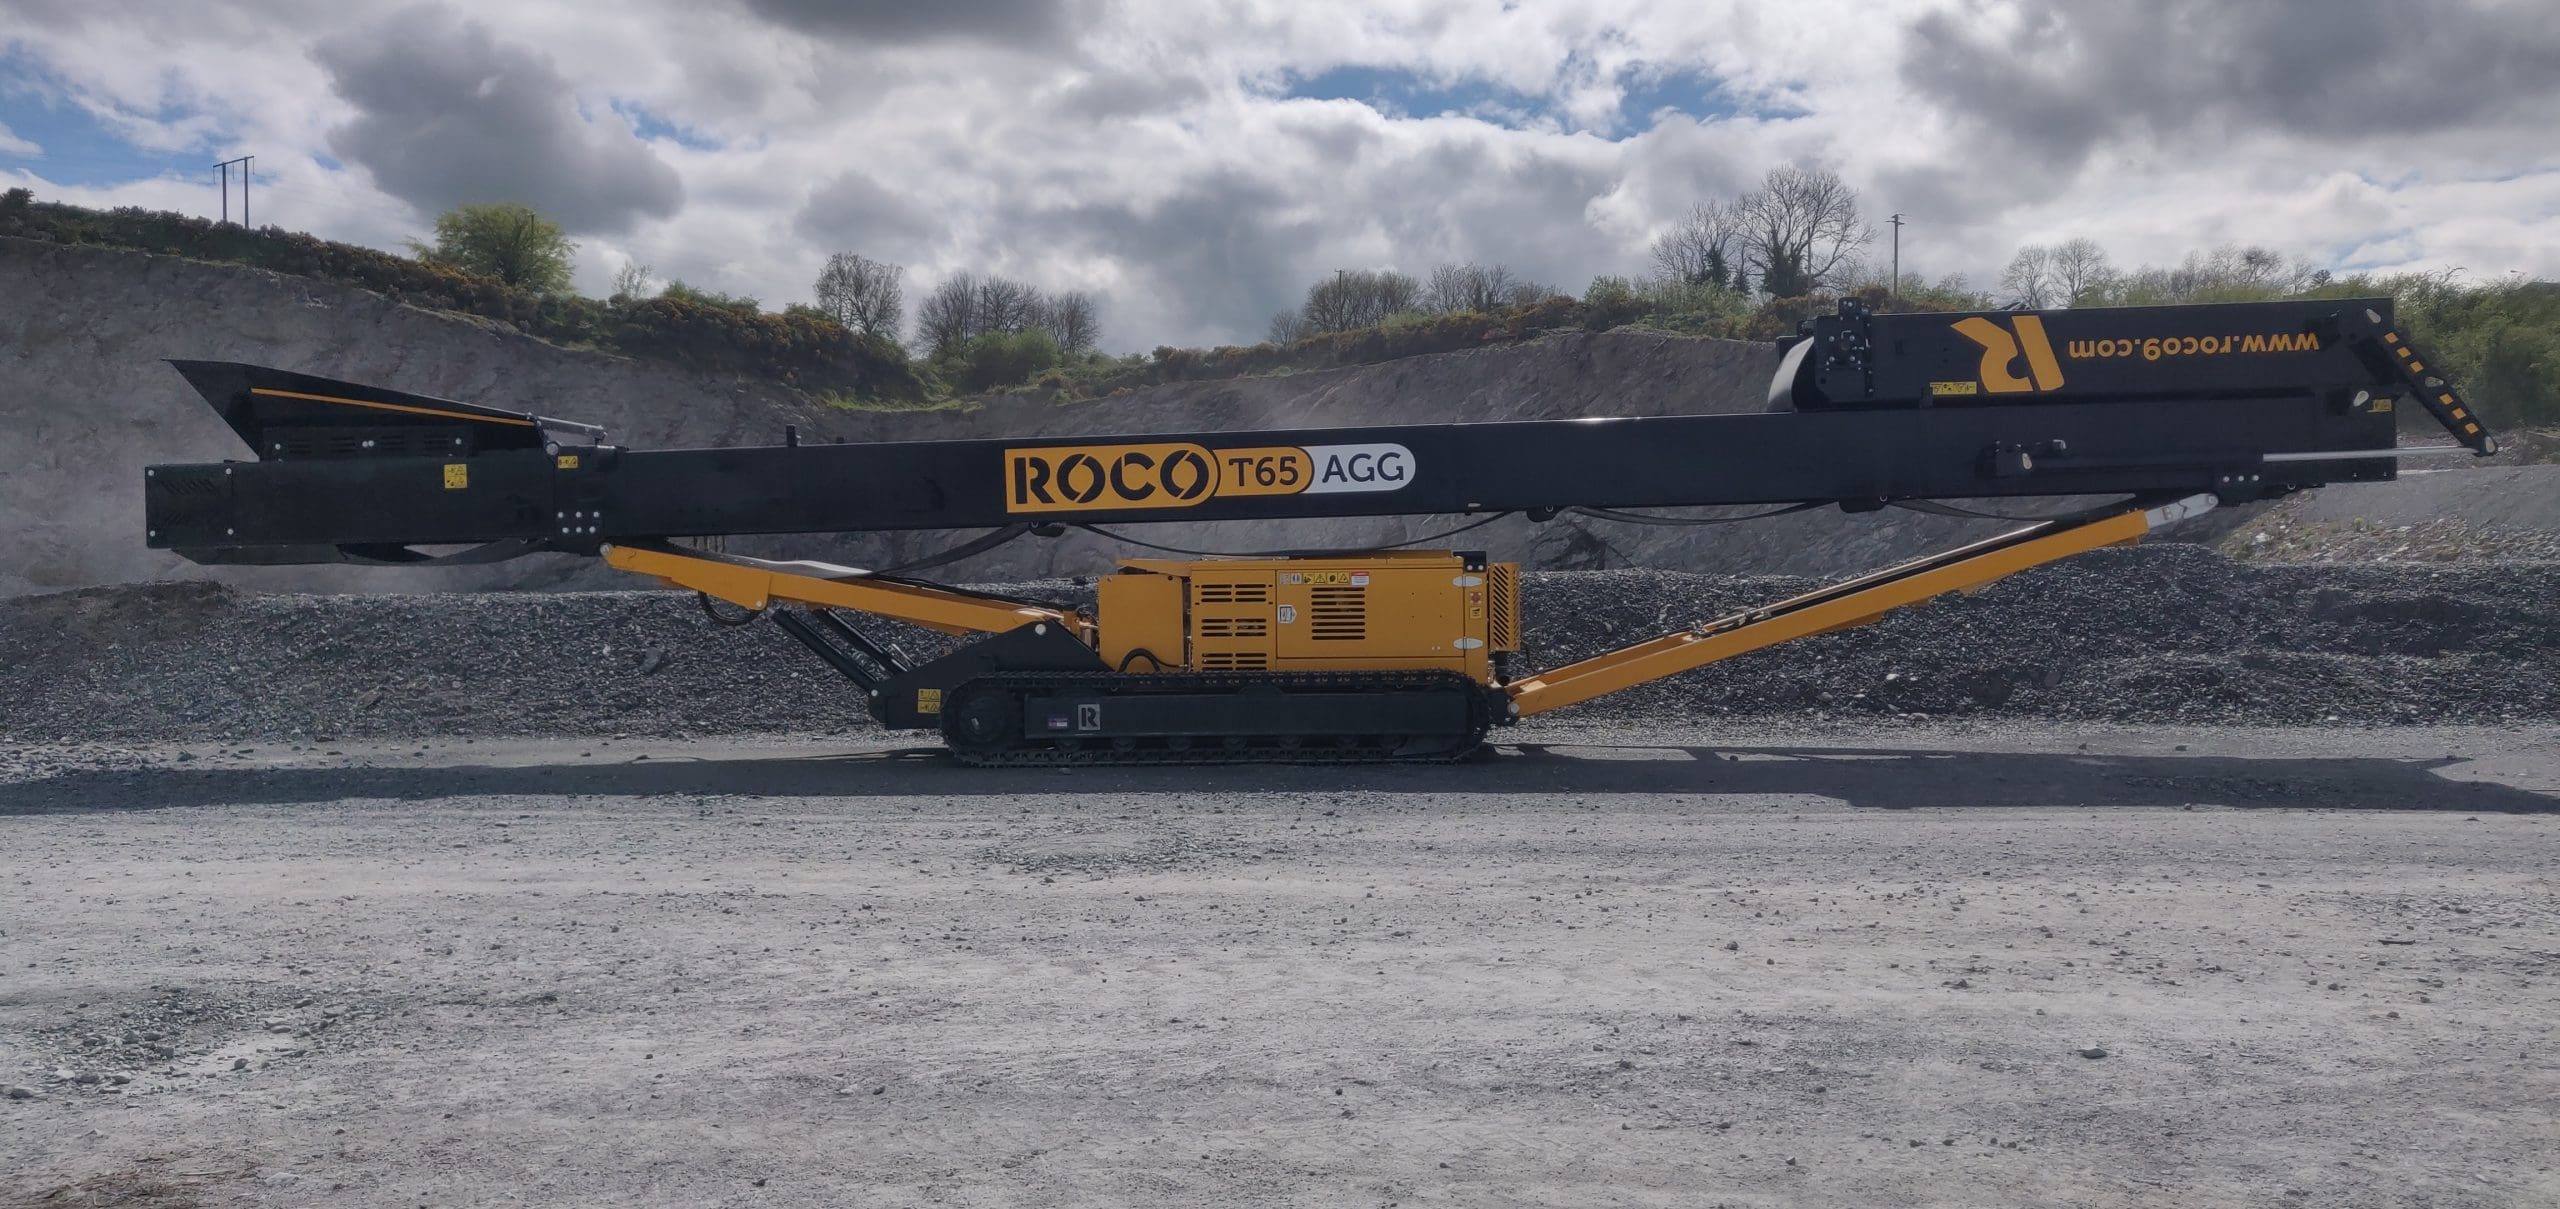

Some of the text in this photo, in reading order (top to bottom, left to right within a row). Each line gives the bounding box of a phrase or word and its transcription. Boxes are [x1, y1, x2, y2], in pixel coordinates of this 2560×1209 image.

[1950, 315, 2065, 393] R
[2068, 332, 2320, 360] www.roco9.com
[1013, 449, 1405, 505] ROCO T65 AGG
[1081, 707, 1098, 728] R
